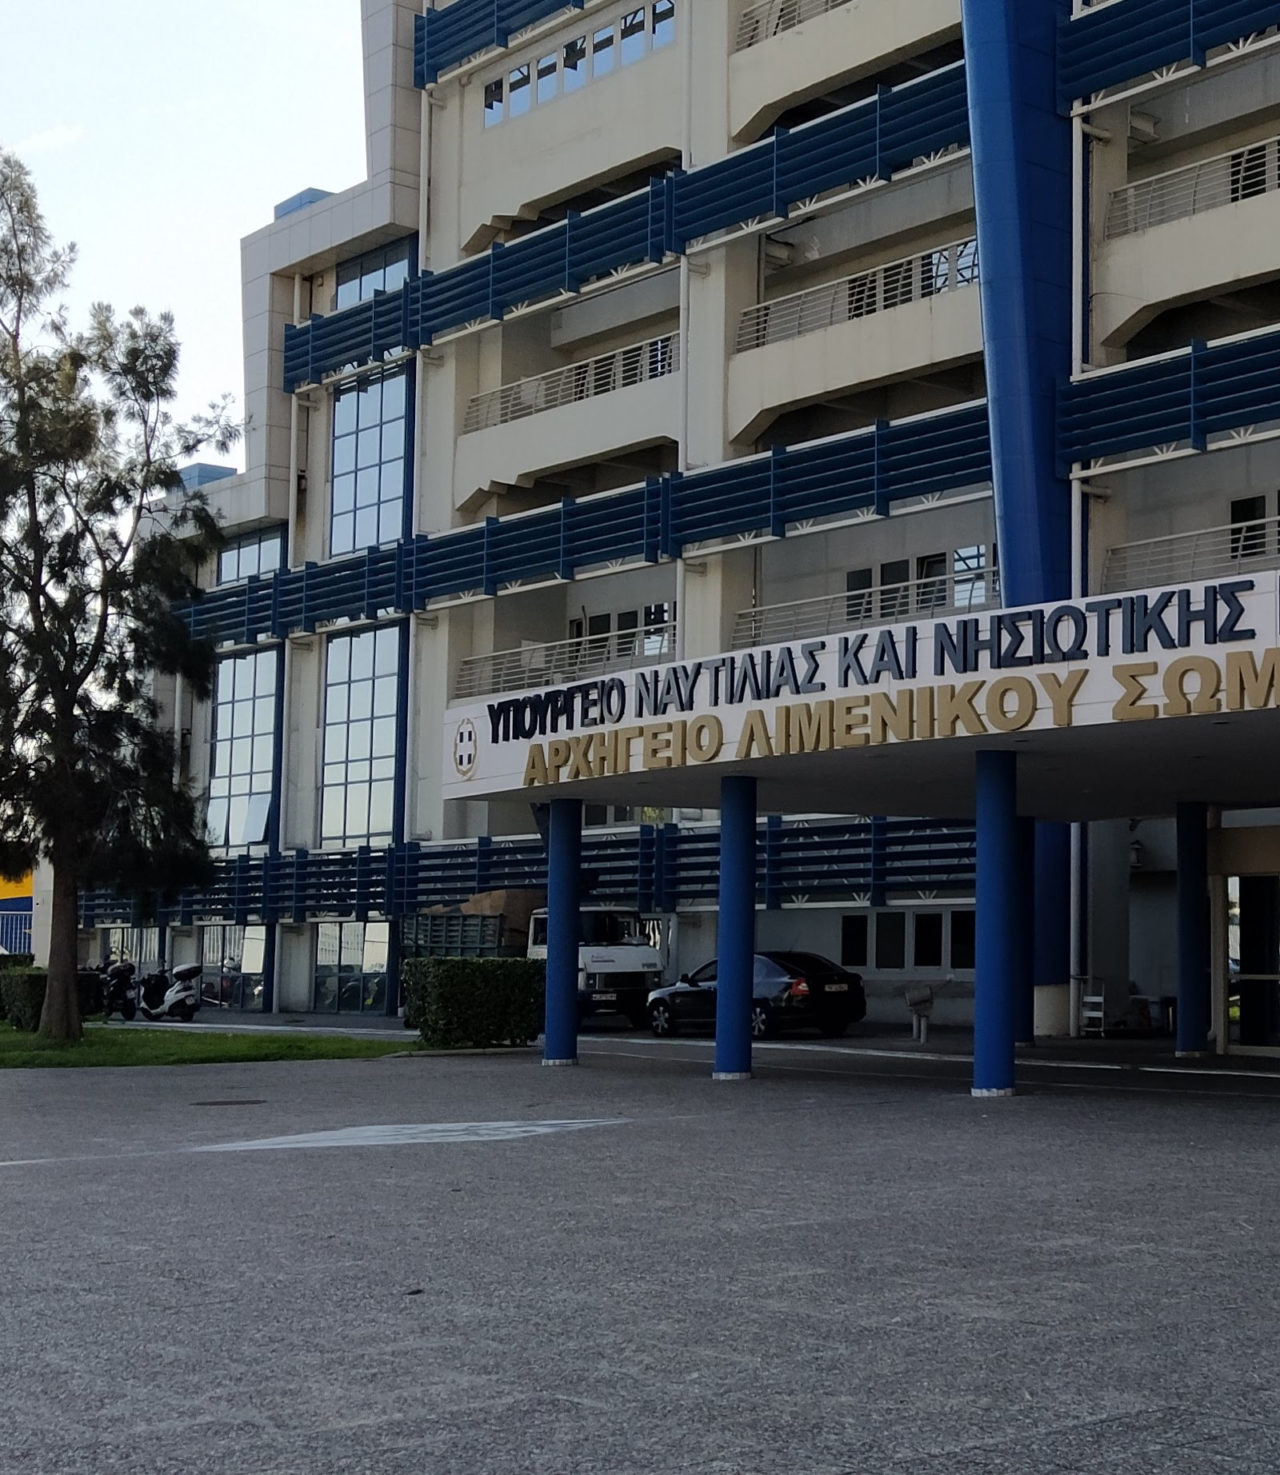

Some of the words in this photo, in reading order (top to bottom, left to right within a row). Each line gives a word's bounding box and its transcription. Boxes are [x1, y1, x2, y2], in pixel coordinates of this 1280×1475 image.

[487, 677, 626, 744] ΥΠΟΥΡΓΕΙΟ
[635, 641, 826, 718] ΝΑΥΤΙΛΙΑΣ
[838, 626, 918, 688] ΚΑΙ
[934, 579, 1256, 676] ΝΗΣΙΩΤΙΚΗΣ
[523, 714, 724, 787] ΑΡΧΗΓΕΙΟ
[735, 669, 1089, 759] ΛΙΜΕΝΙΚΟΥ
